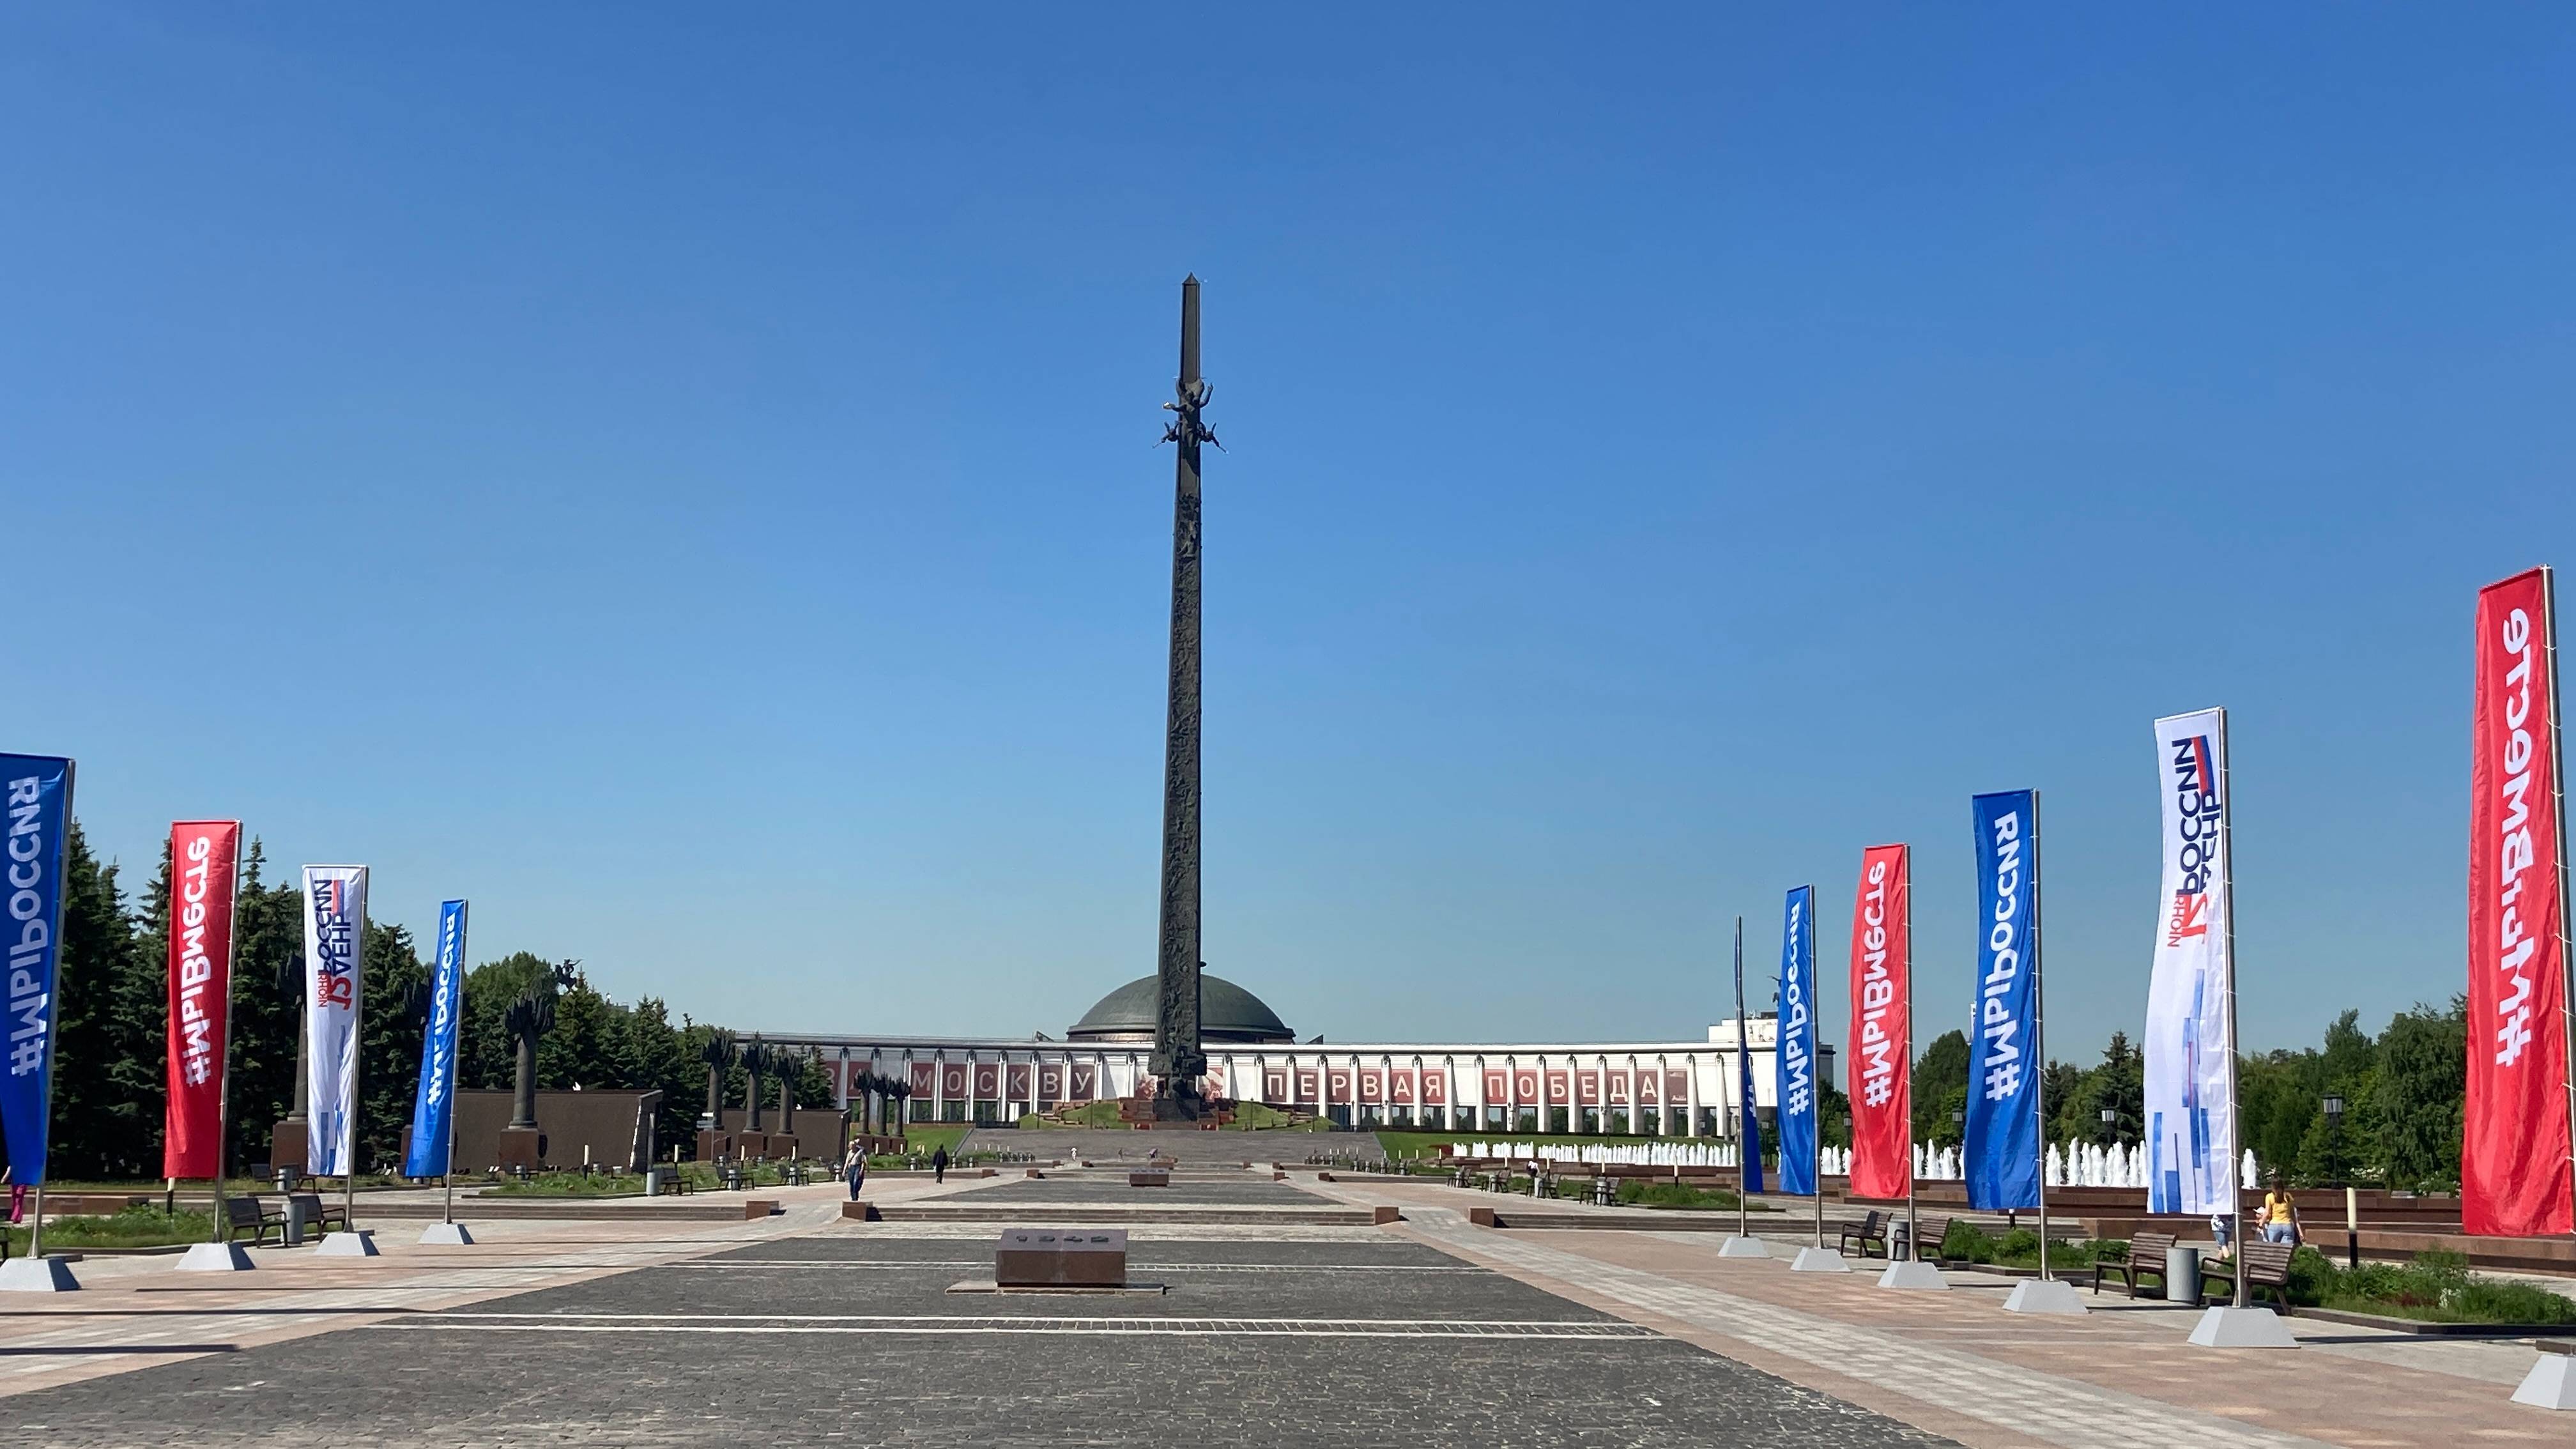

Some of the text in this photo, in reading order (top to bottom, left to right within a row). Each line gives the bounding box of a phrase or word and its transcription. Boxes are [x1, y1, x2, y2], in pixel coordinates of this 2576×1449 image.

[912, 1070, 1092, 1095] МОСКВУ
[1267, 1073, 1658, 1102] ПЕРВАЯ ПОБЕДА
